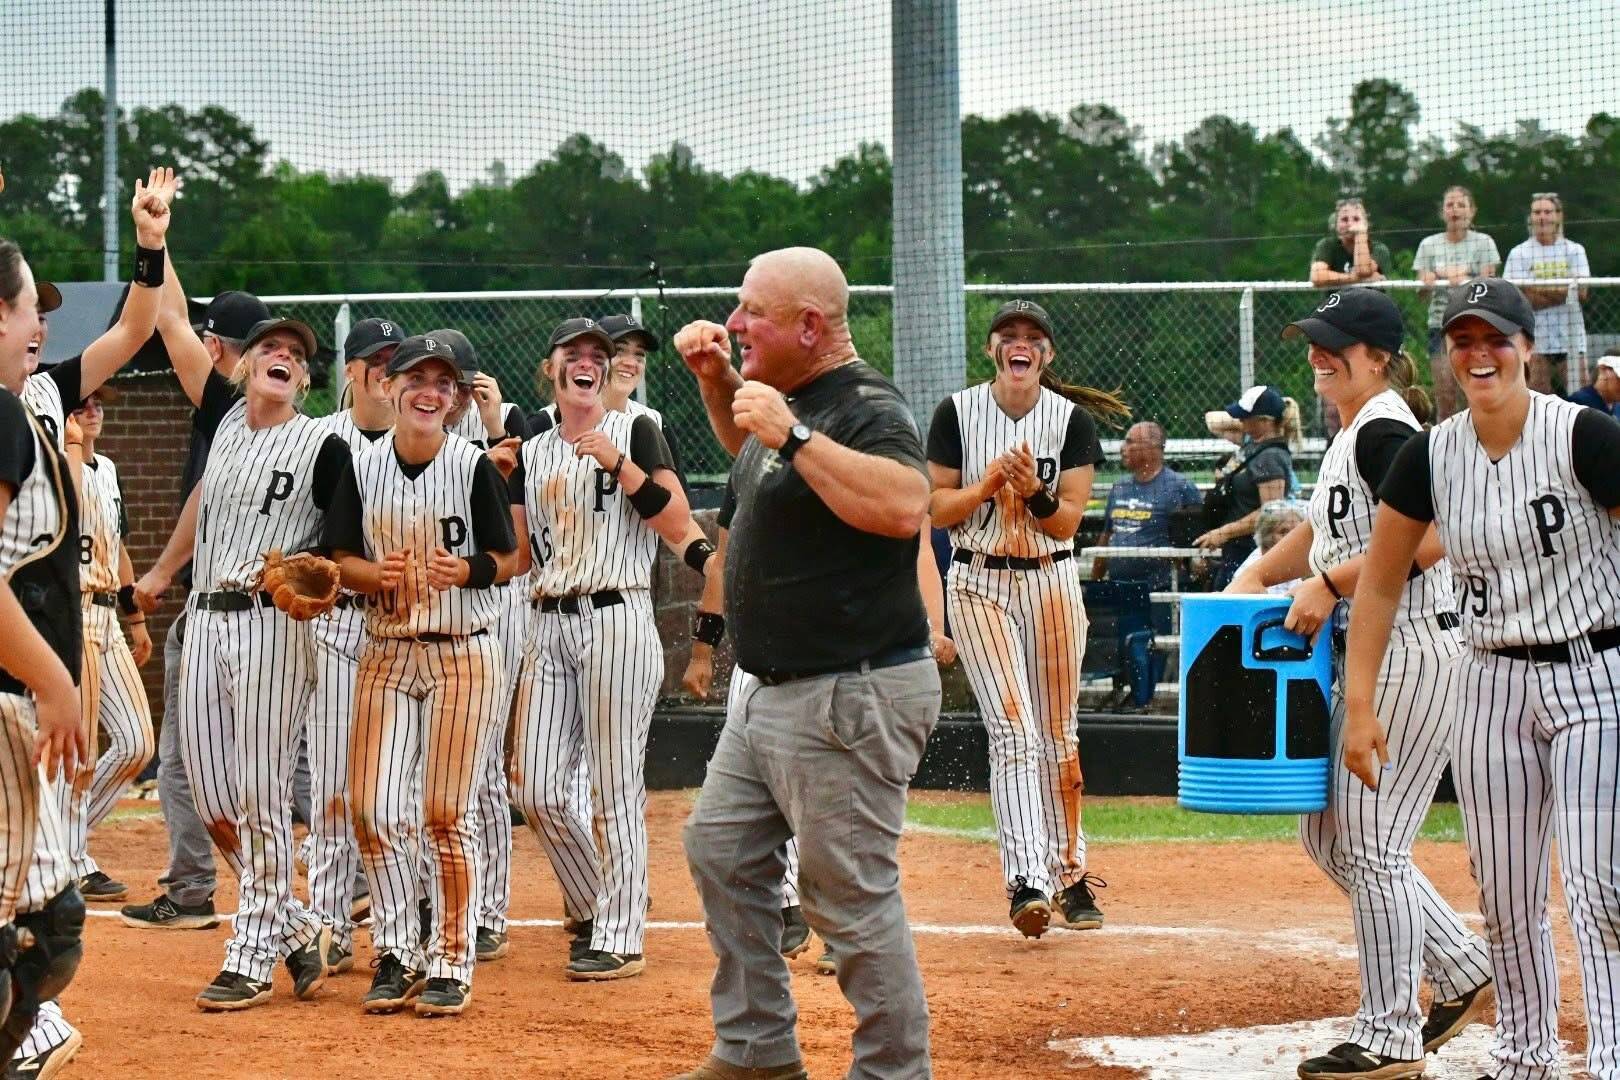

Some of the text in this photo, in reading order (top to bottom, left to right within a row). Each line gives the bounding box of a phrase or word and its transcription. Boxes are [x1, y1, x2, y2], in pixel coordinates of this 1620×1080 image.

[1016, 299, 1029, 311] P
[1317, 293, 1340, 312] P
[1467, 282, 1488, 303] P
[382, 322, 392, 337] P
[426, 339, 436, 350] P
[258, 469, 294, 516] P
[593, 468, 619, 512] P
[1327, 484, 1351, 538] P
[1529, 494, 1565, 557] P
[439, 516, 469, 555] P
[531, 526, 553, 568] 15
